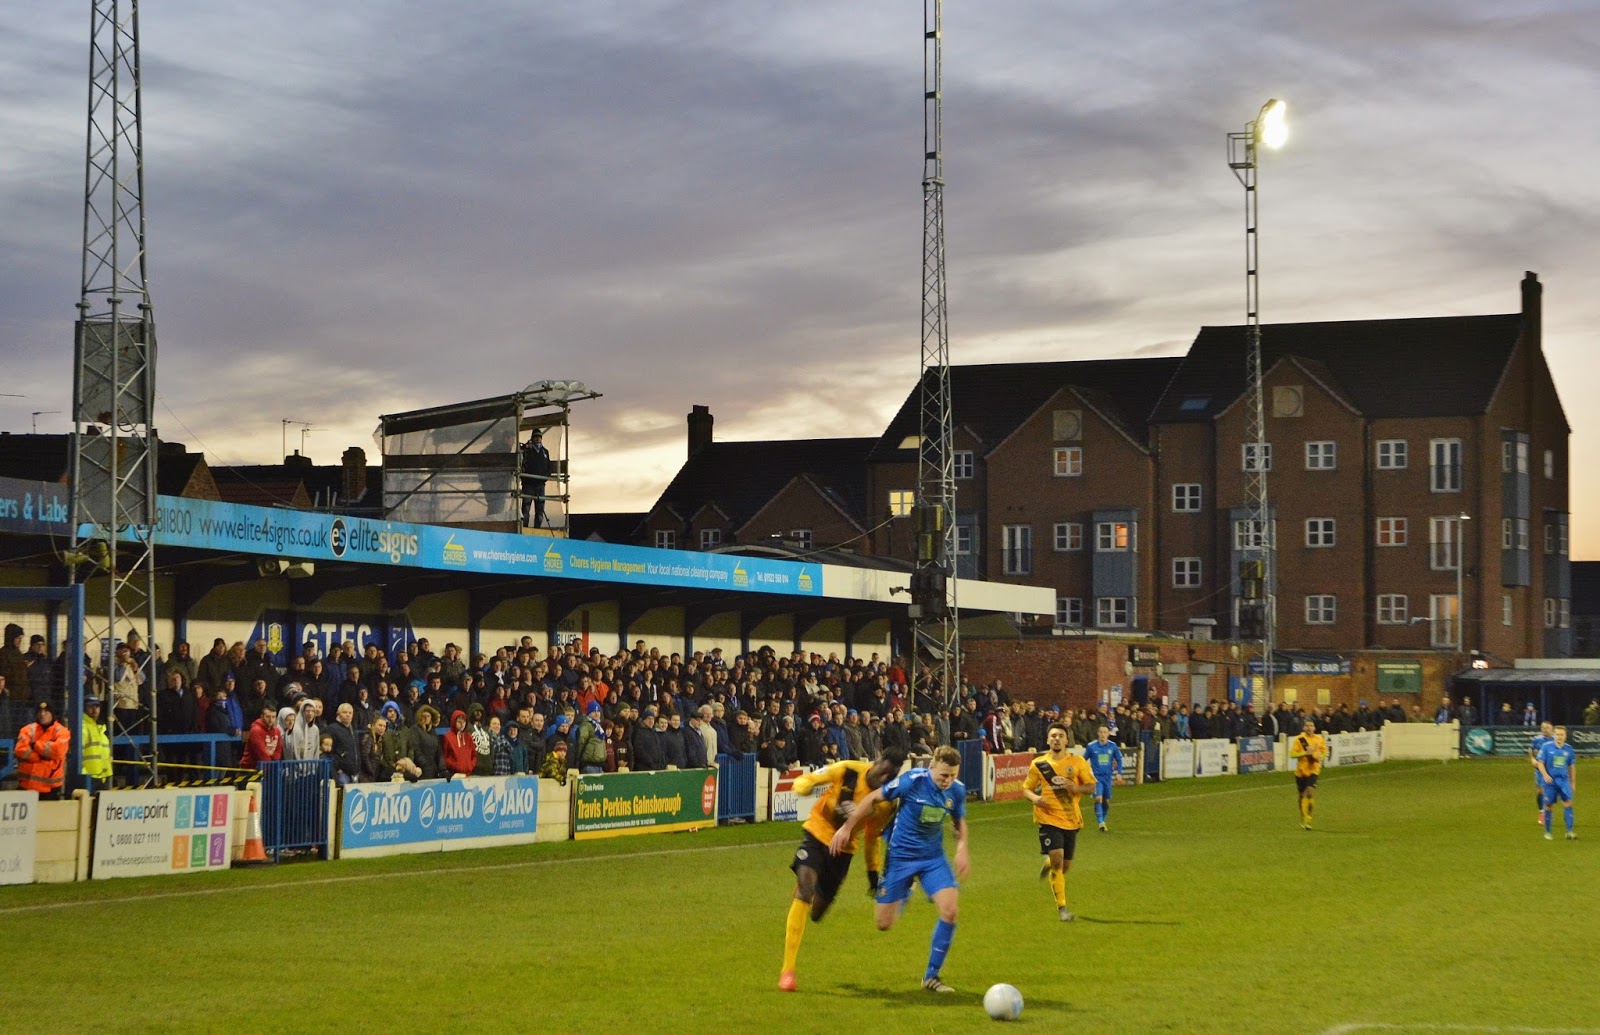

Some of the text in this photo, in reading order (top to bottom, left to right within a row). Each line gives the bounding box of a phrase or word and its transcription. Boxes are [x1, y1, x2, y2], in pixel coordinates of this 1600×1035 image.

[23, 493, 33, 520] &
[199, 515, 328, 552] www.elite4signs.co.uk
[443, 549, 467, 563] CHORES
[543, 557, 563, 569] CHORES
[569, 555, 589, 569] Chores
[590, 556, 612, 573] Hygiene
[612, 558, 646, 575] Management
[1321, 663, 1340, 672] BAR
[2, 802, 28, 820] LTD
[106, 798, 169, 824] theonepoint
[371, 794, 412, 826] JAKO
[437, 791, 475, 821] JAKO
[500, 788, 534, 817] JAKO
[578, 798, 601, 819] Travis
[602, 797, 632, 817] Perkins
[633, 793, 682, 816] Gainsborough
